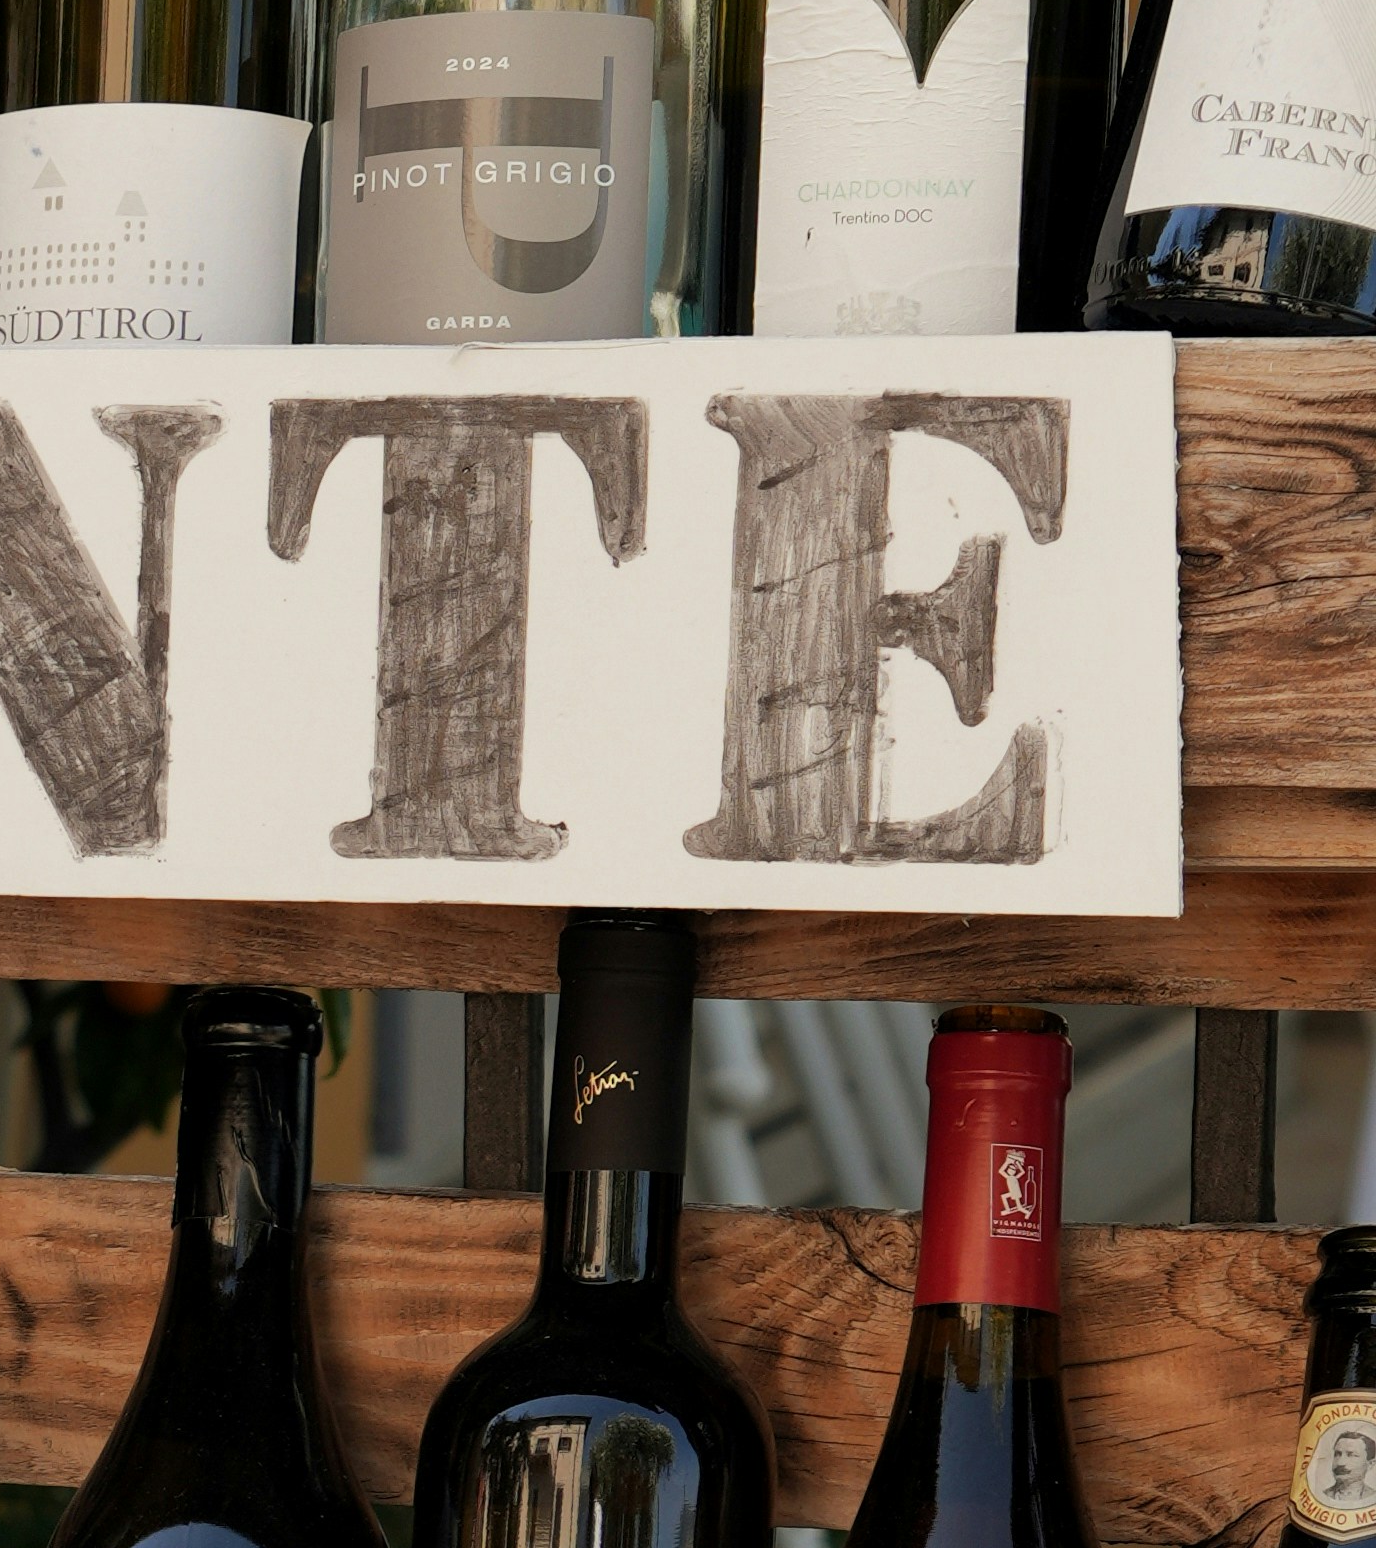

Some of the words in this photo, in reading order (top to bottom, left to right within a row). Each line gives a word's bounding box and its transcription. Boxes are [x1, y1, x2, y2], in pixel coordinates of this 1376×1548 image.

[444, 55, 512, 72] 2024
[352, 162, 453, 196] PINOT
[474, 160, 618, 189] GRIGIO
[797, 178, 976, 204] CHARDONNAY
[831, 209, 890, 225] Trentino
[894, 208, 934, 223] DOC
[424, 314, 512, 331] GARDA
